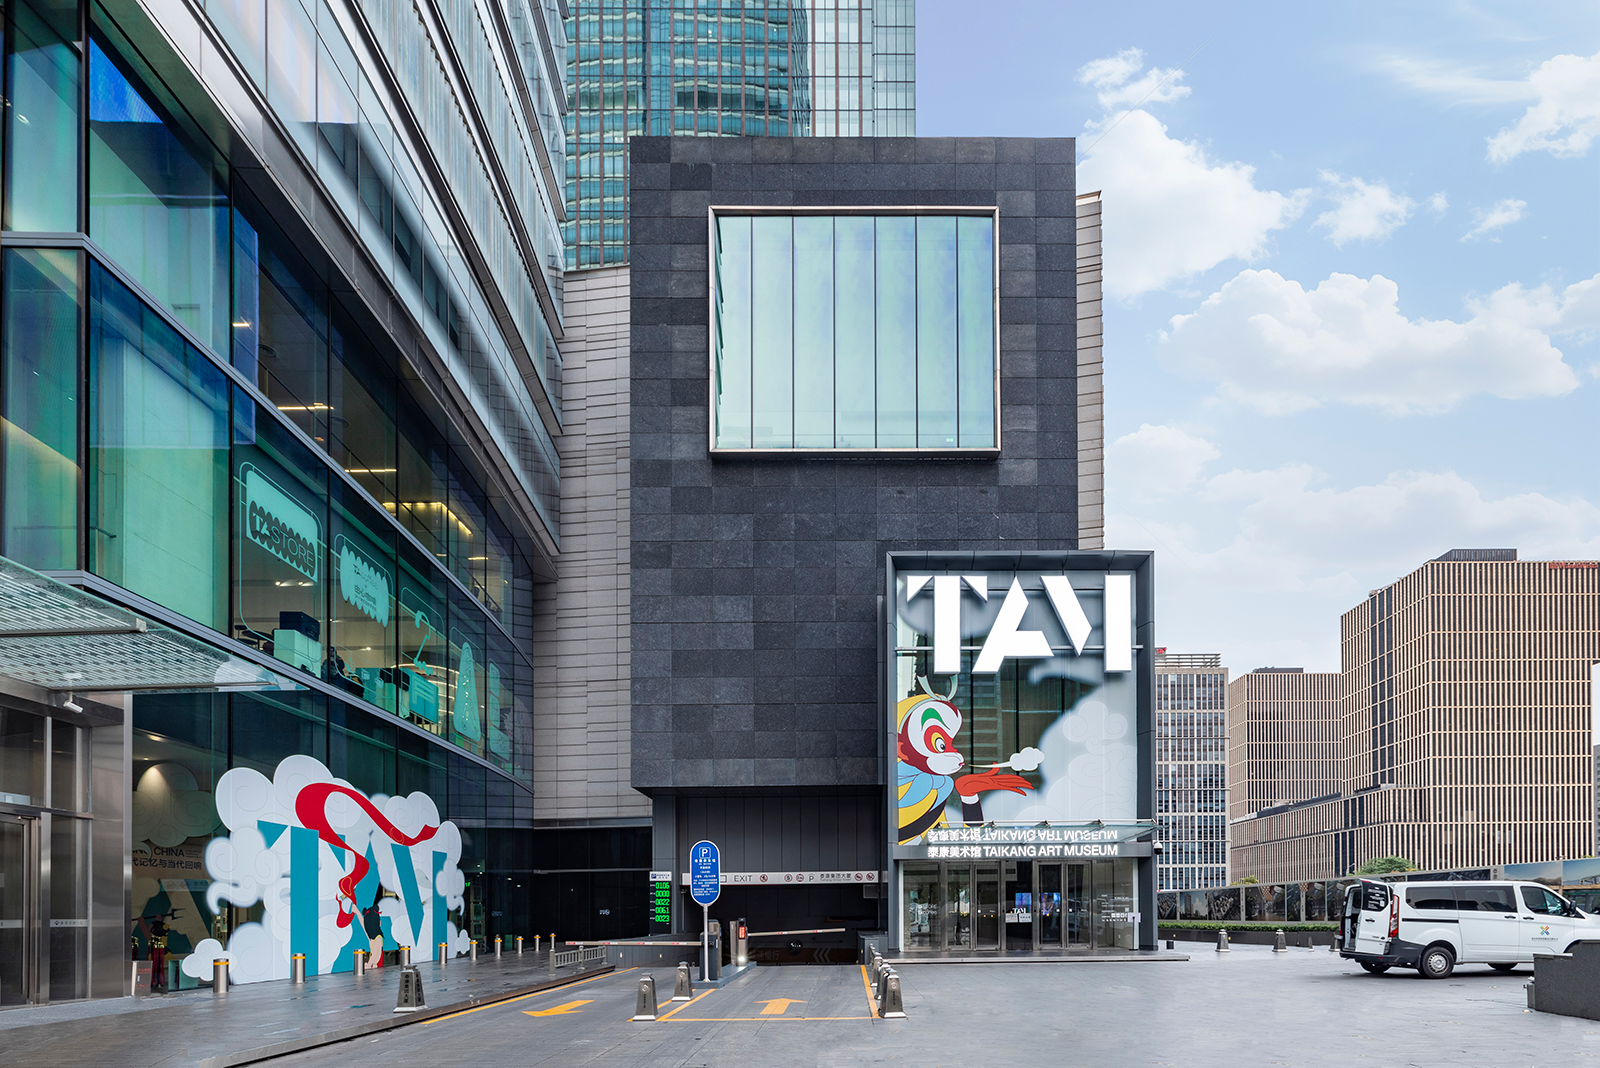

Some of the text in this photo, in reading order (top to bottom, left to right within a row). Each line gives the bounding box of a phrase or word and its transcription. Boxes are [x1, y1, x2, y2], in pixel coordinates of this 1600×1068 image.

[153, 846, 185, 858] CHINA
[927, 844, 1118, 859] 泰康美术馆 TAIKANG ART MUSEUM
[733, 874, 753, 882] EXIT
